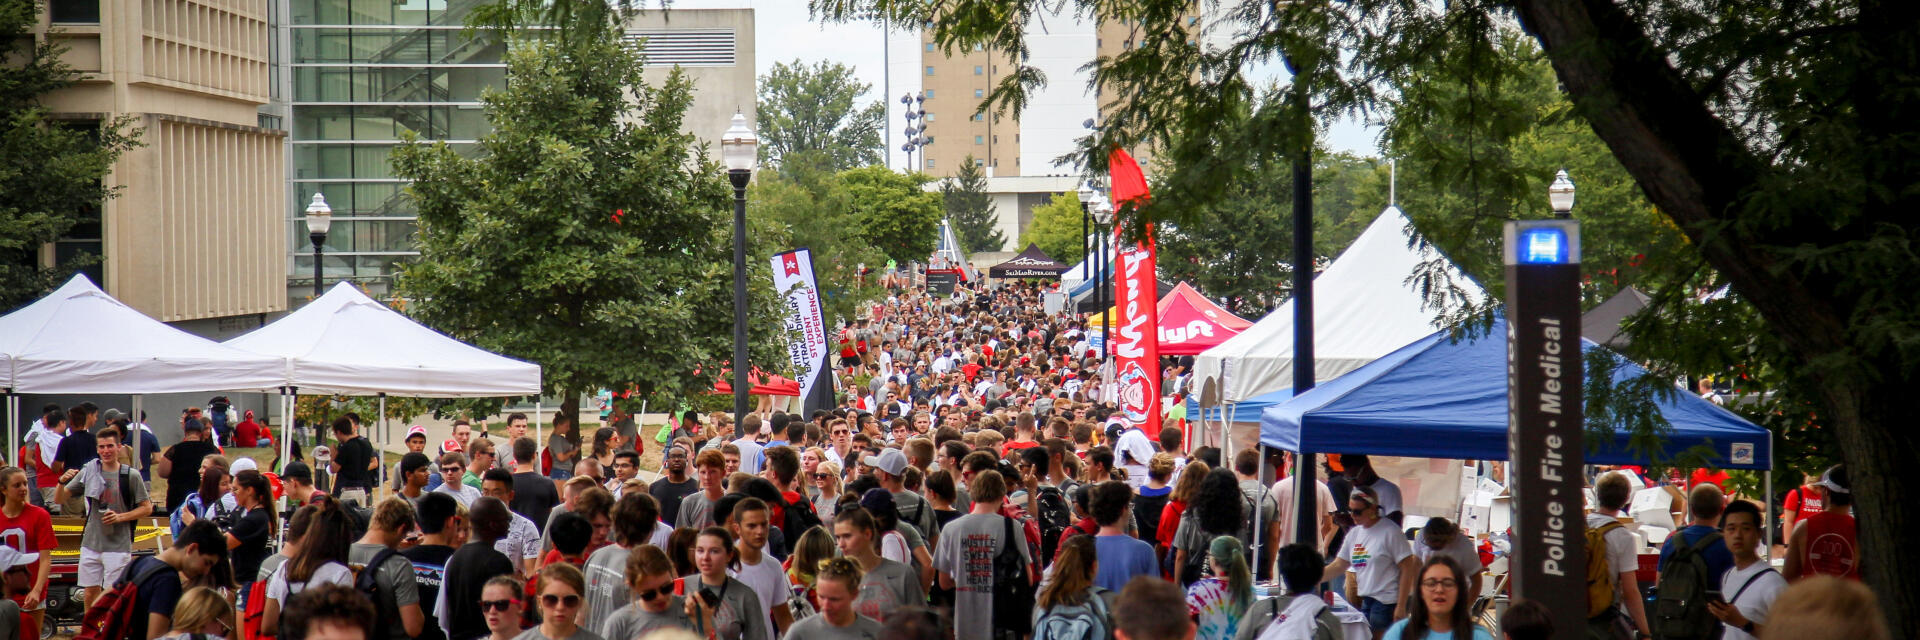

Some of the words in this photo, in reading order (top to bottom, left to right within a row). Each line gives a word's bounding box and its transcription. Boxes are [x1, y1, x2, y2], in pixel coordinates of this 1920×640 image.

[804, 316, 818, 358] STUDENT
[1539, 318, 1562, 414] Medical
[1541, 434, 1563, 483] Fire
[961, 538, 996, 548] HUSTLE
[1543, 502, 1565, 577] Police
